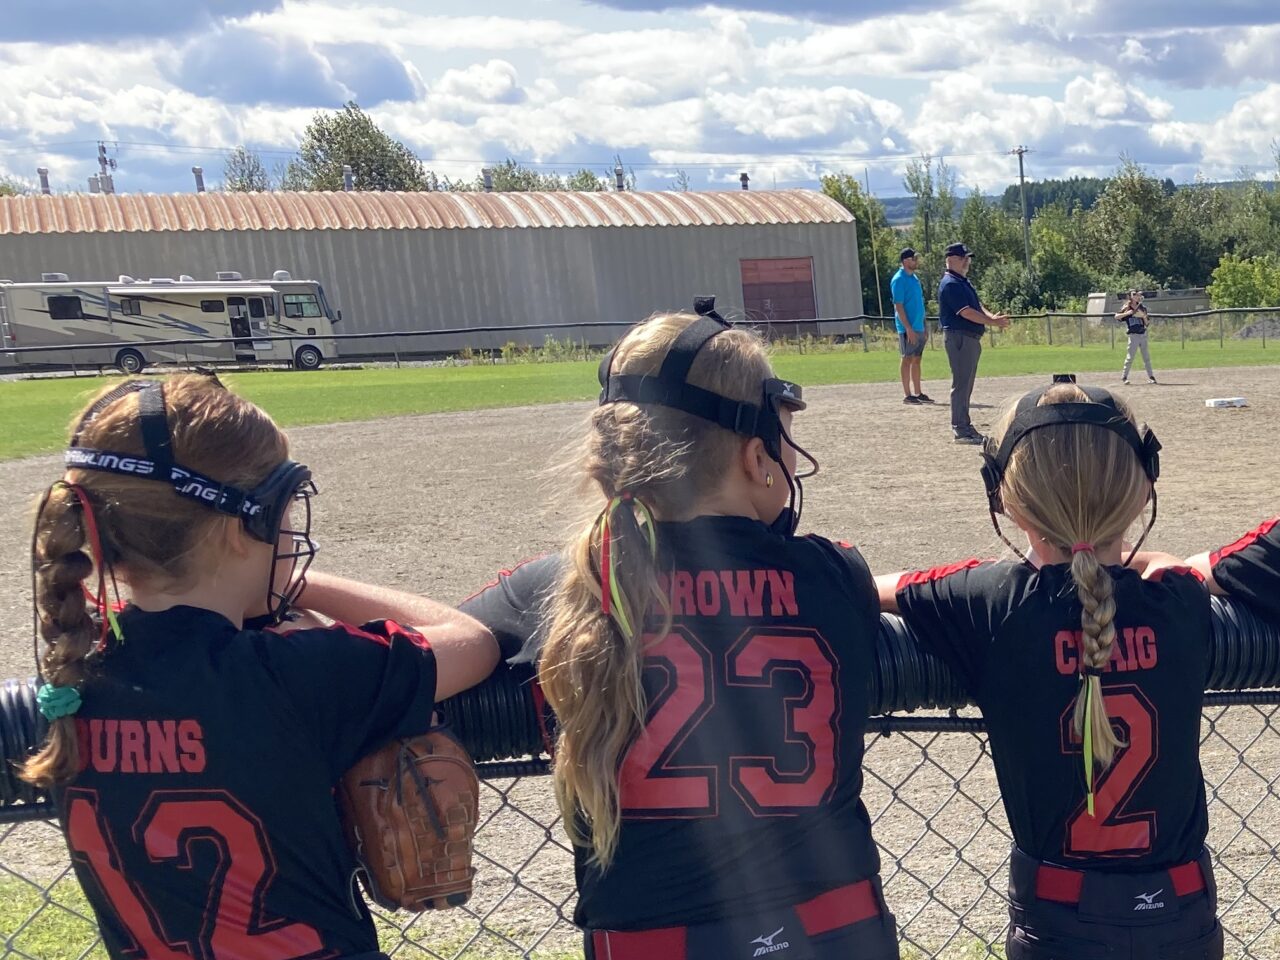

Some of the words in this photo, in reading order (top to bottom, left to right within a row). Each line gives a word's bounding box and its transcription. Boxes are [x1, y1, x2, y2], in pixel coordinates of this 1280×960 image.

[619, 624, 842, 818] 23
[1054, 626, 1157, 675] CAIG
[1060, 683, 1159, 858] 2
